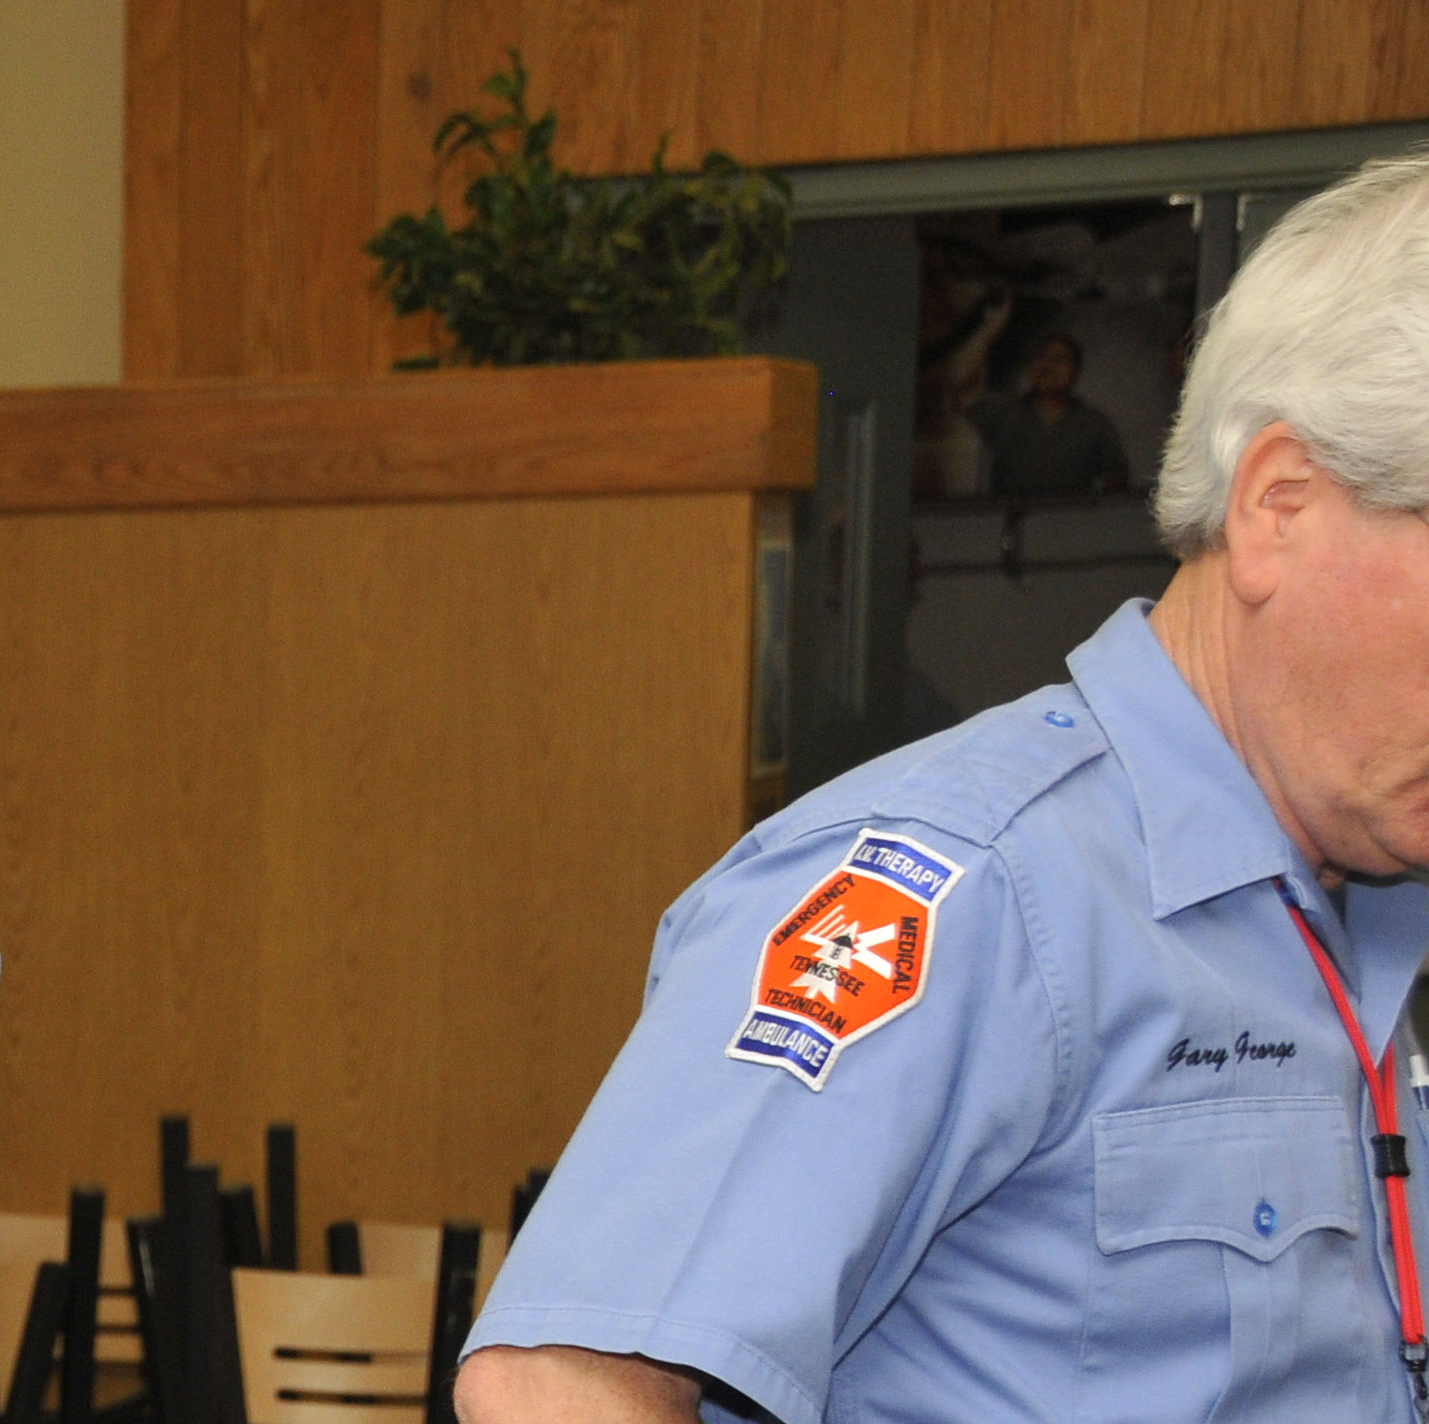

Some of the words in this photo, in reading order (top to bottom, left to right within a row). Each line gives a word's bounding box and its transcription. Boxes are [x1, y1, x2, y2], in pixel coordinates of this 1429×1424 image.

[874, 847, 946, 894] THERAPY
[772, 873, 857, 947] EMERGENCY
[789, 954, 866, 997] TENNESSEE
[891, 915, 919, 994] MEDICAL
[765, 988, 848, 1034] TECHNICIAN
[743, 1018, 829, 1068] AMBULANCE
[1166, 1038, 1229, 1073] Gary
[1234, 1030, 1297, 1068] George
